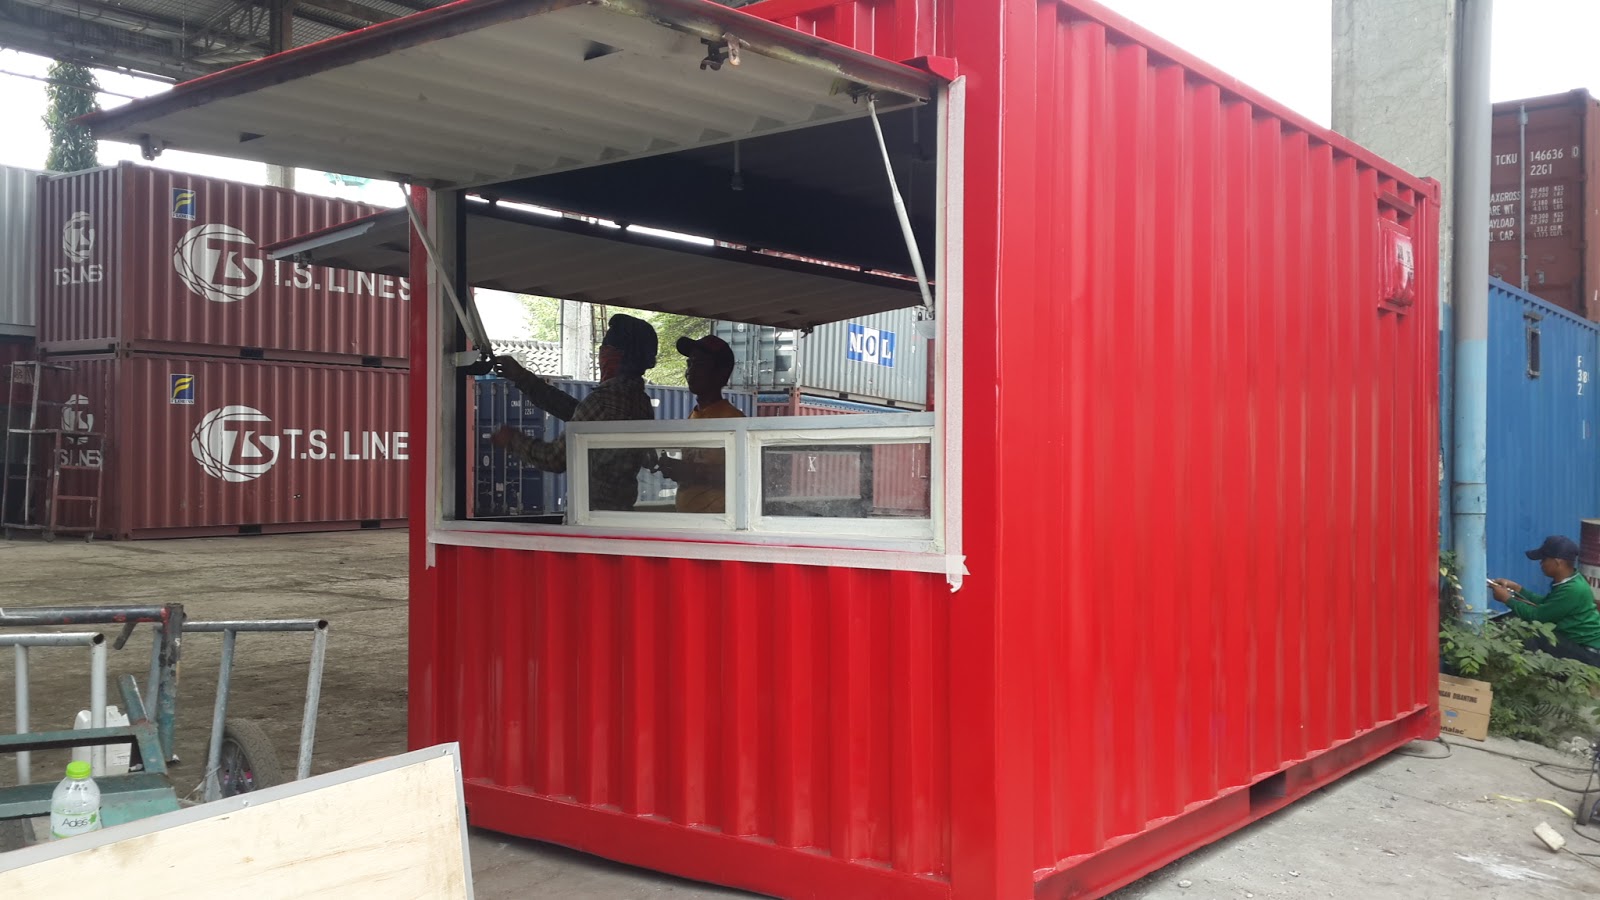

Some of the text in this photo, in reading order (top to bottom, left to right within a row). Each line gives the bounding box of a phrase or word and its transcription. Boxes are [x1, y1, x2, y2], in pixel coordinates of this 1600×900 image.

[1495, 153, 1517, 165] TCKU
[1530, 148, 1563, 161] 146636
[1530, 164, 1552, 175] 22G1
[1490, 191, 1521, 203] AXGROSS
[1489, 205, 1501, 216] ARE
[1489, 217, 1515, 229] AYLOAD
[328, 266, 410, 300] LINES
[849, 331, 892, 359] NOL
[283, 428, 336, 460] T.S.
[343, 431, 409, 460] LINE
